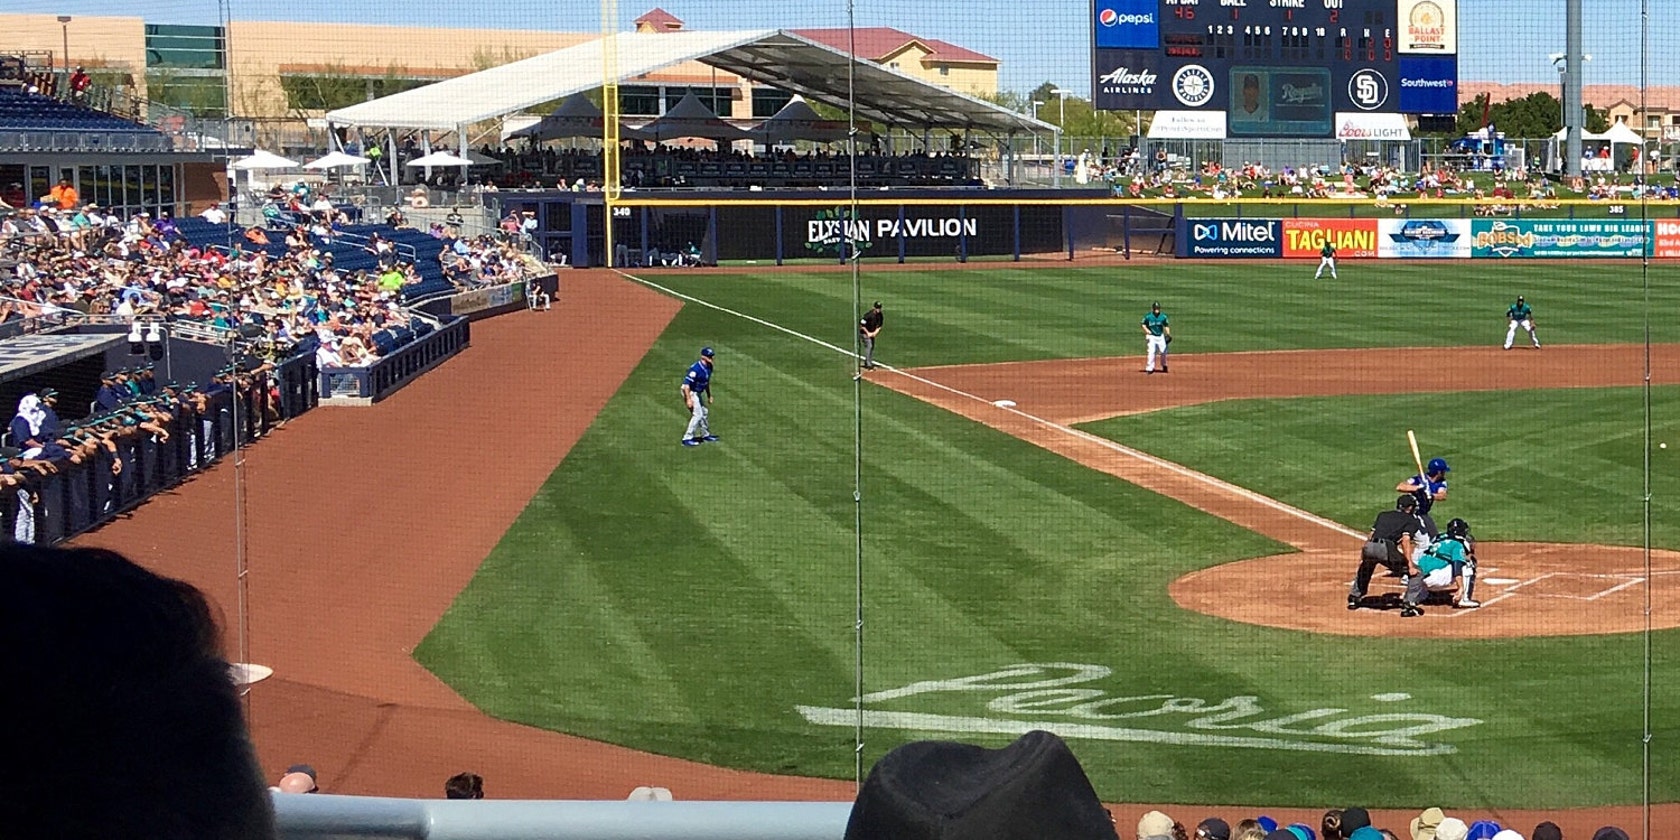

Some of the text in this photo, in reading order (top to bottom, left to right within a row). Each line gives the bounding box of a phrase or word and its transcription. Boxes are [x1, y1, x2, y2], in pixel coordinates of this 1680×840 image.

[1270, 0, 1304, 8] STRIKE
[1324, 0, 1343, 8] OUT
[1118, 13, 1154, 25] pepsi
[1216, 25, 1223, 34] 2
[1226, 25, 1233, 34] 3
[1244, 26, 1251, 34] 4
[1254, 26, 1261, 35] 5
[1264, 26, 1270, 35] 6
[1100, 67, 1157, 86] Alaska
[1401, 78, 1447, 88] Southwest
[1374, 128, 1403, 138] LIGHT
[613, 207, 631, 216] 340
[877, 218, 977, 238] PAVILION
[1222, 222, 1275, 241] Mitel
[1285, 229, 1375, 251] TAGLIANI
[1194, 246, 1228, 254] Powering
[850, 662, 1484, 748] Peoria
